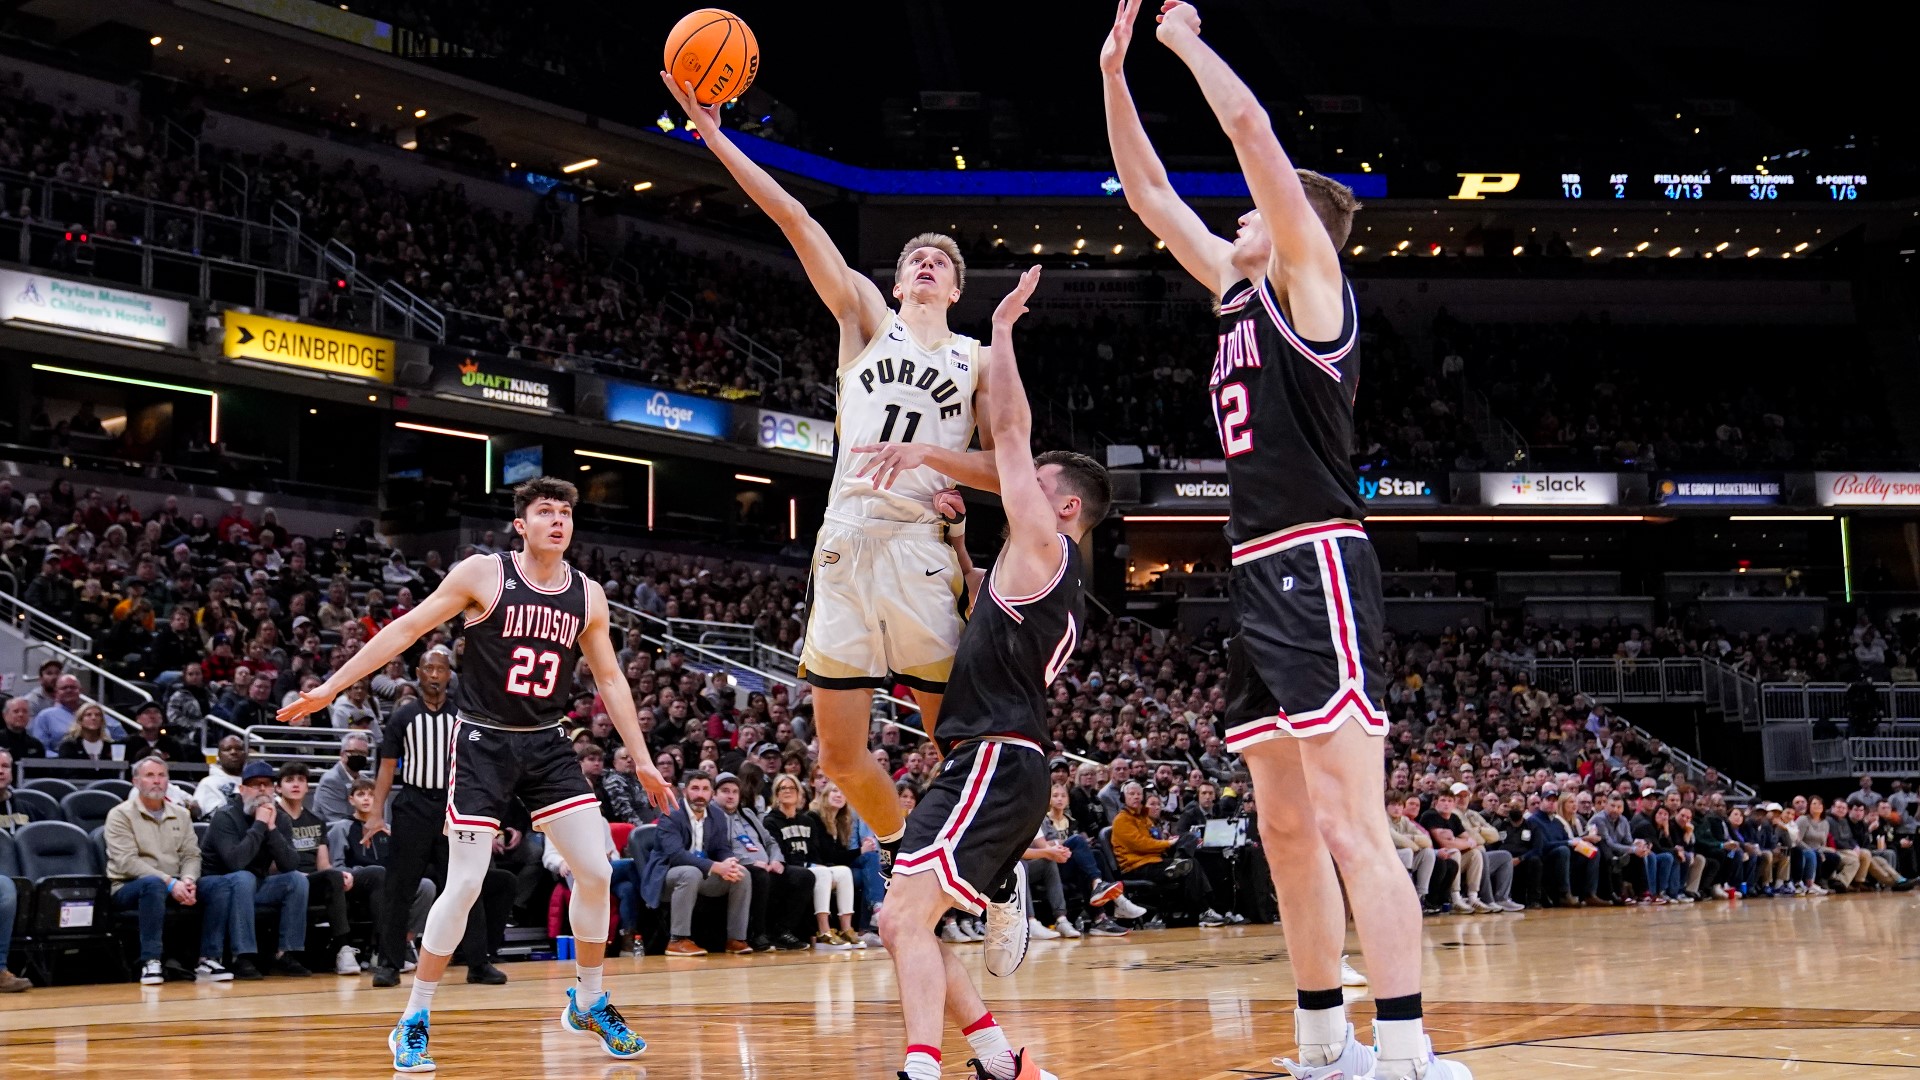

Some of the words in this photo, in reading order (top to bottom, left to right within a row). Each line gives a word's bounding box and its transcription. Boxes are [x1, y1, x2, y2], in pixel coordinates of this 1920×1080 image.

[1448, 172, 1520, 200] P
[1609, 173, 1629, 184] AST
[1653, 174, 1681, 184] FIELD
[1730, 174, 1755, 185] FREE
[1755, 174, 1795, 185] THROWS
[1561, 183, 1582, 199] 10
[1614, 183, 1625, 199] 2
[1664, 183, 1703, 200] 4/13
[1749, 184, 1778, 200] 3/6
[1829, 184, 1858, 201] 1/6
[51, 281, 95, 300] Peyton
[98, 290, 152, 312] Manning
[51, 297, 112, 318] Children's
[116, 307, 166, 328] Hospital
[262, 329, 386, 373] GAINBRIDGE
[482, 387, 549, 408] SPORTSBOOK
[859, 357, 962, 421] PURDUE
[646, 391, 694, 430] Kroger
[760, 413, 812, 450] aes
[816, 432, 834, 453] In
[879, 403, 923, 443] 11
[1536, 475, 1586, 492] slack
[1677, 483, 1691, 496] WE
[1715, 483, 1761, 496] BASKETBALL
[1833, 473, 1890, 501] Bally
[502, 604, 579, 649] DAVIDSON
[506, 646, 562, 698] 23
